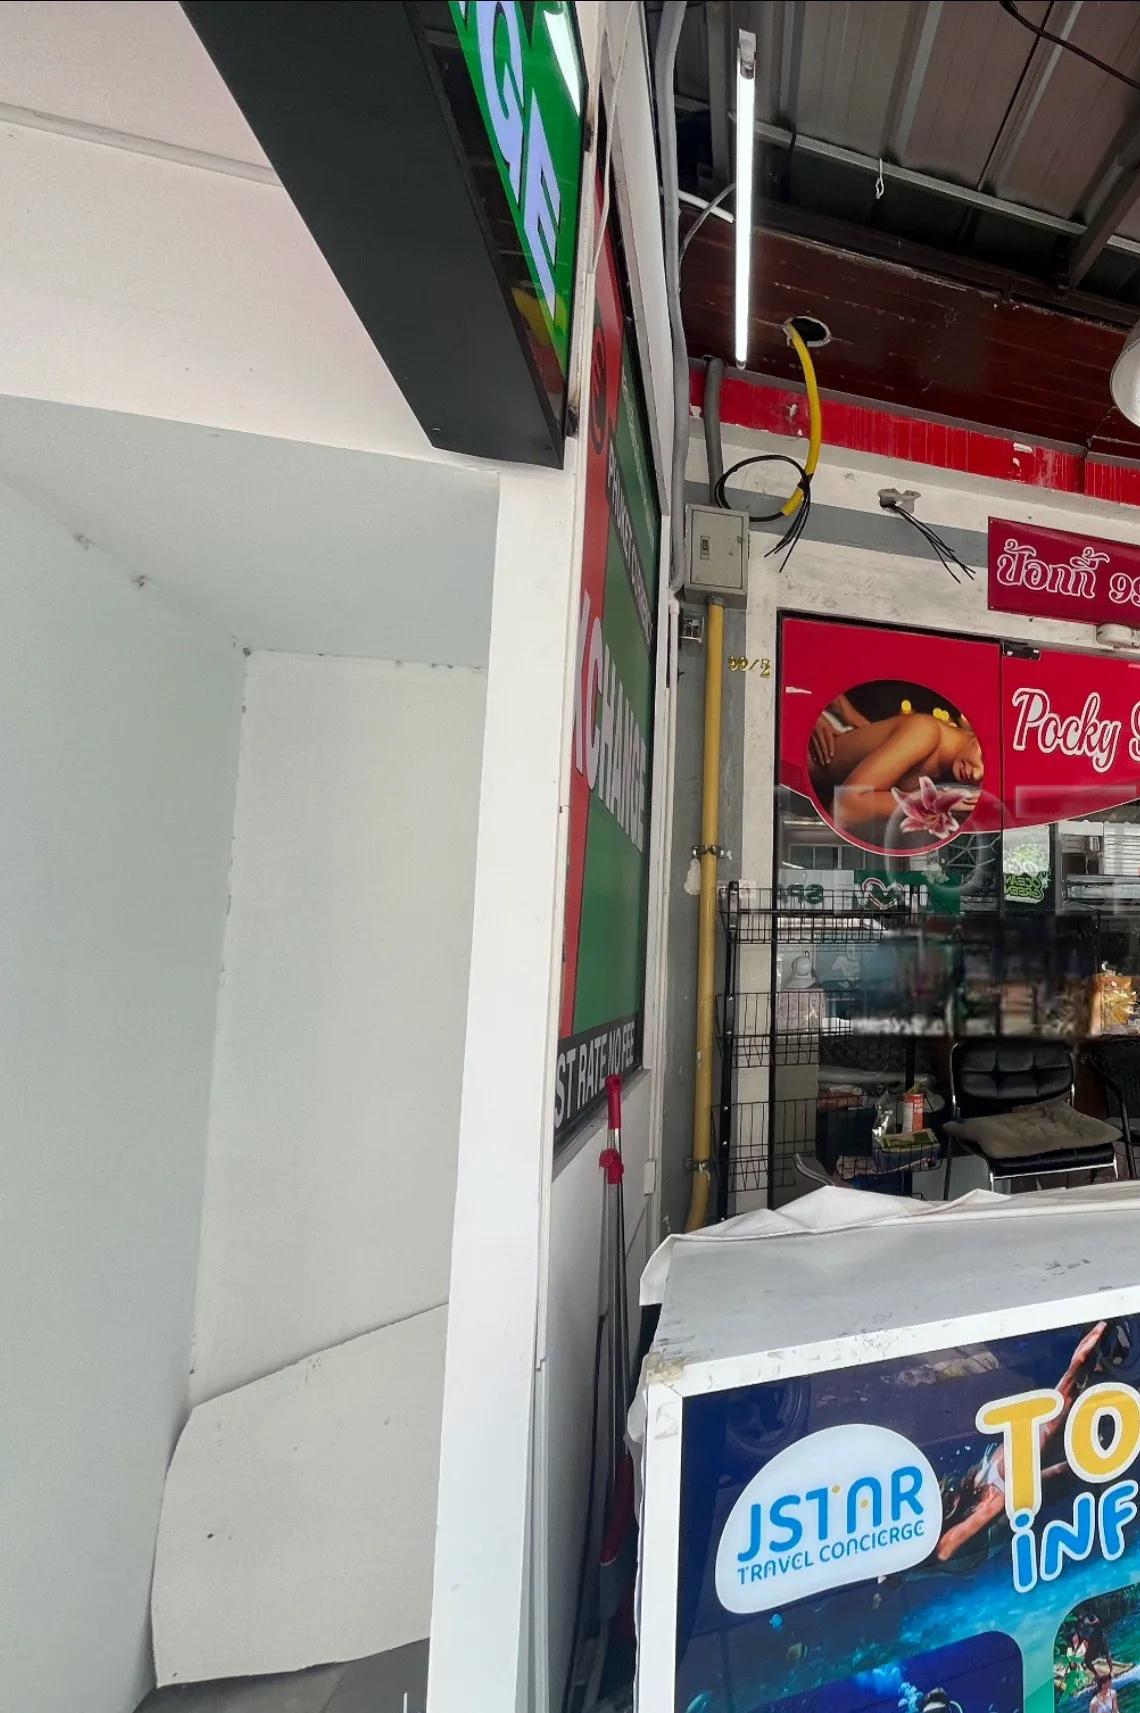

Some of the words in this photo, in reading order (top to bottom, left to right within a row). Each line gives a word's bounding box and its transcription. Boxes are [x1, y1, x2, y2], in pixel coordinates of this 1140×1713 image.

[458, 0, 560, 322] GE
[1012, 687, 1121, 772] Pocky
[577, 1034, 607, 1110] RATE
[608, 1027, 622, 1075] NO
[737, 1466, 924, 1562] JSTAR
[737, 1551, 813, 1585] TRAVEL
[819, 1520, 925, 1564] CONCIERGE
